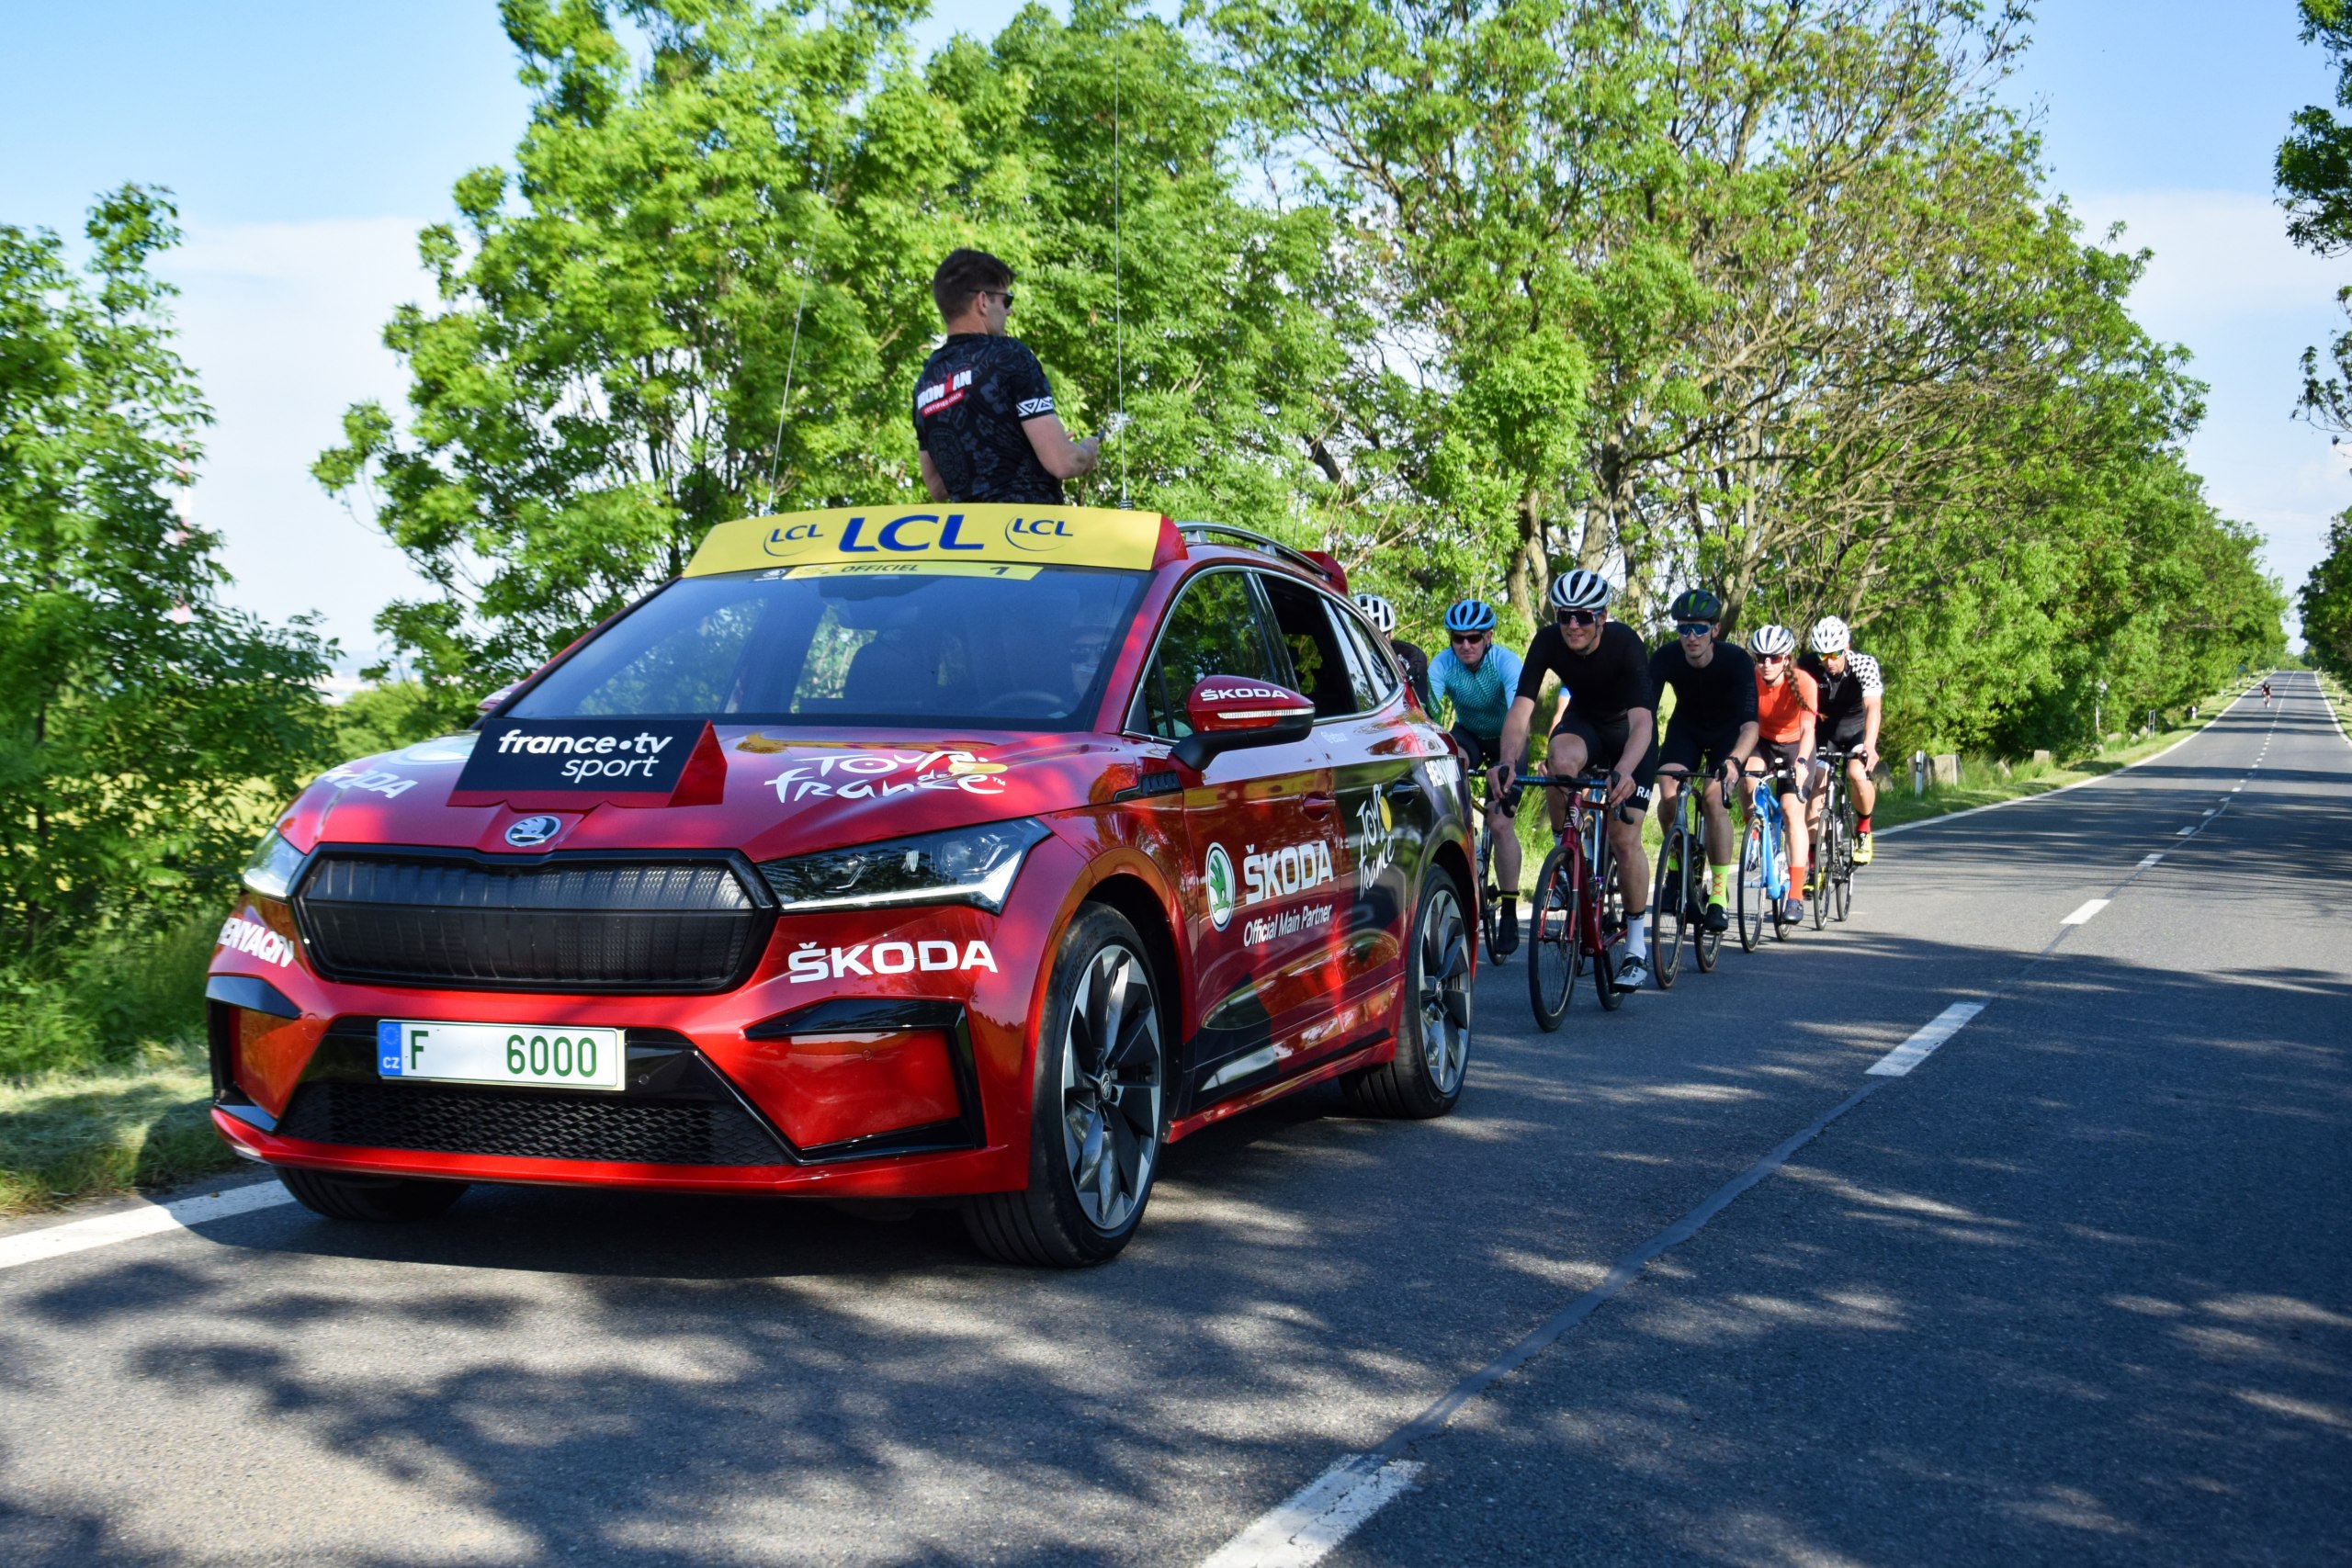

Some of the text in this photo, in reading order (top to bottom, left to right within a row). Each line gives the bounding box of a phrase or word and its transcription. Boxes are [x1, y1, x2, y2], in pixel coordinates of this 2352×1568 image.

[771, 524, 824, 543] LCL
[838, 514, 985, 553] LCL
[1012, 517, 1074, 537] LCL
[841, 563, 919, 573] OFFICIEL
[989, 566, 1010, 576] 1
[1200, 688, 1290, 702] ŠKODA
[560, 755, 661, 784] sport
[1243, 840, 1334, 906] ŠKODA
[1243, 903, 1332, 947] Official Main Partner
[788, 940, 999, 984] ŠKODA
[382, 1030, 597, 1078] CZ F 6000
